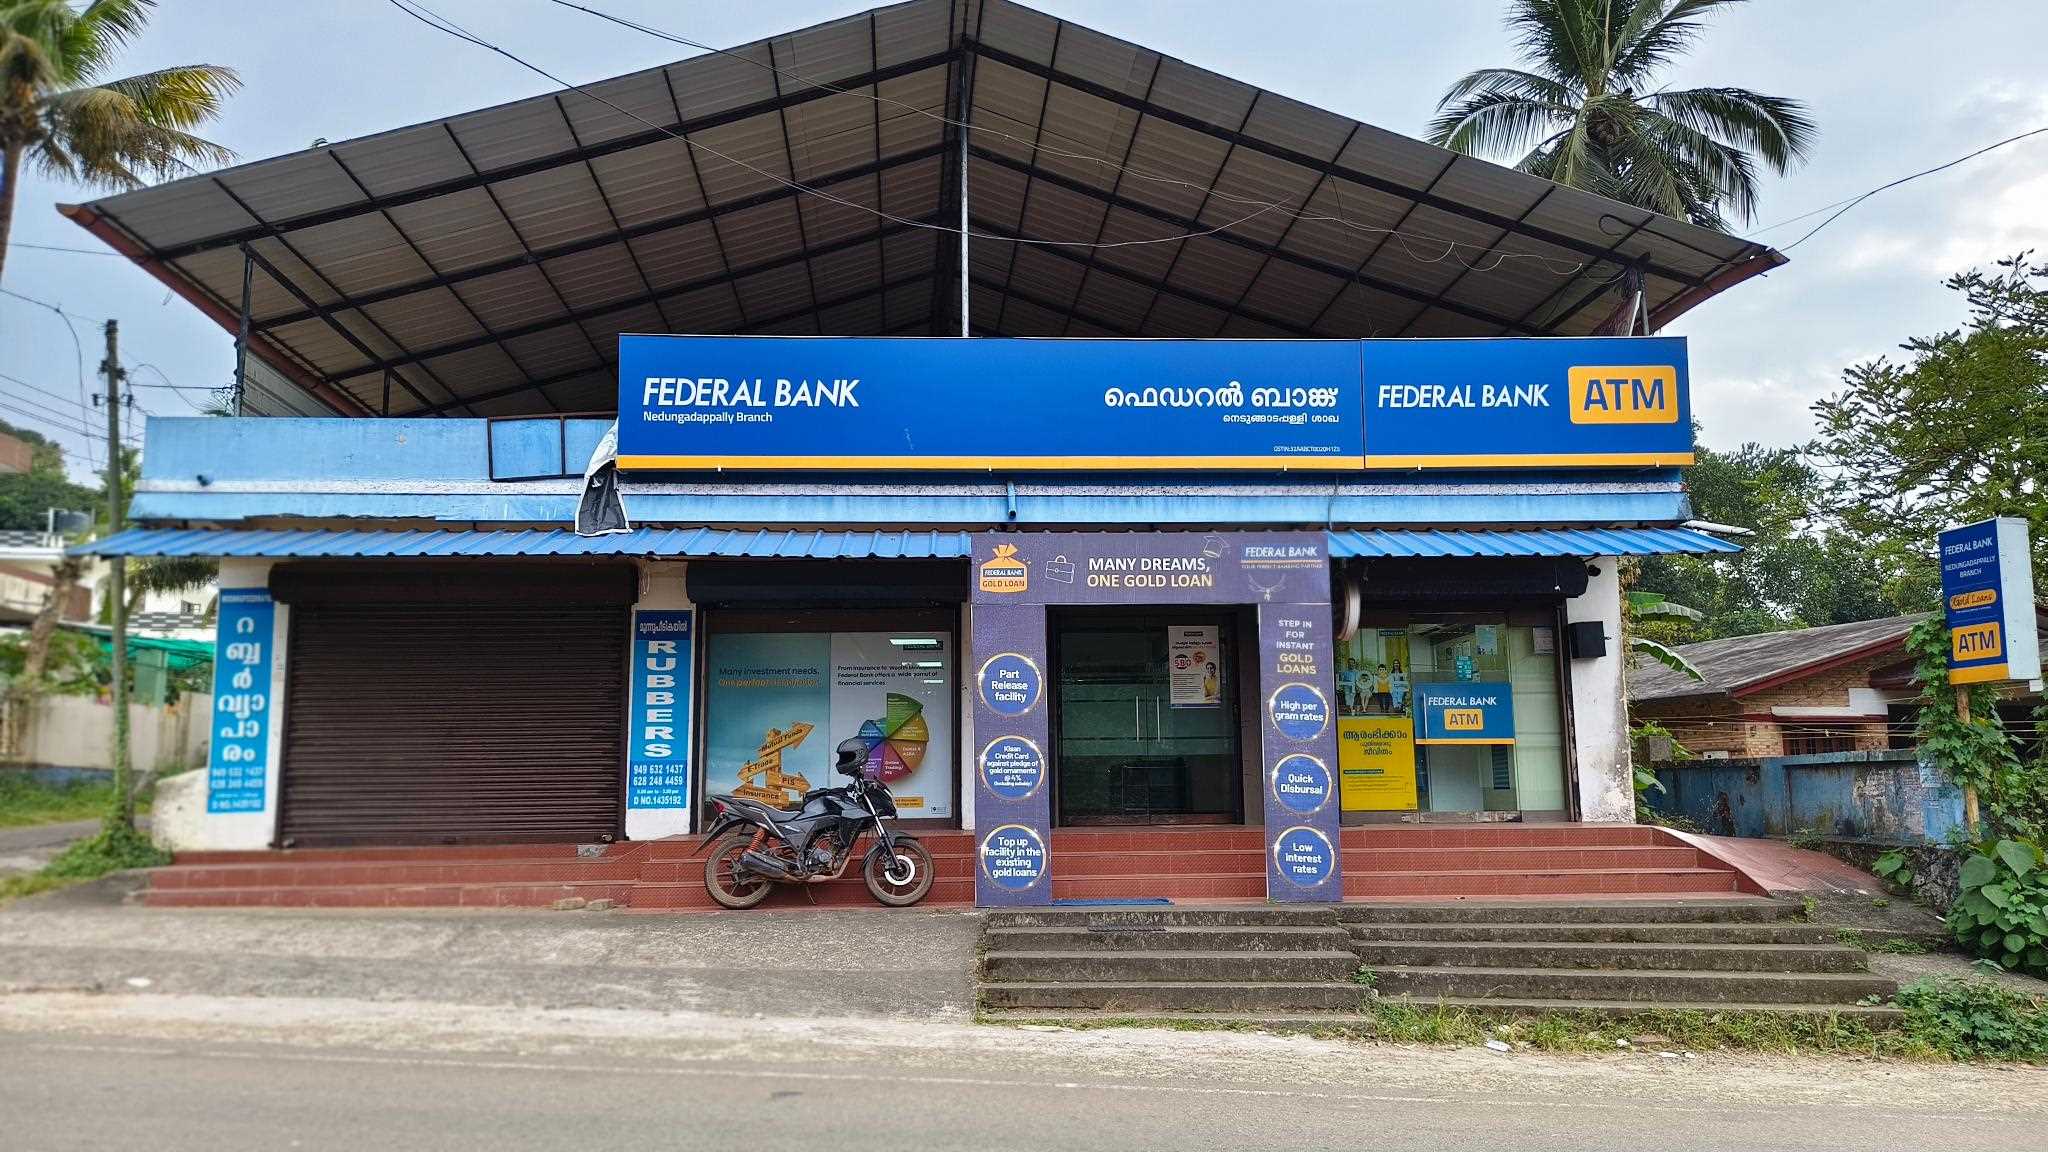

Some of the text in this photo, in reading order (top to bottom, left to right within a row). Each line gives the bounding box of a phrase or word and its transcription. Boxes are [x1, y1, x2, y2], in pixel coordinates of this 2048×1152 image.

[643, 377, 860, 408] FEDERAL BANK
[1104, 381, 1339, 407] ഫെഡറൽ ബാങ്ക്
[1378, 384, 1550, 408] FEDERAL BANK
[1584, 379, 1665, 411] ATM
[643, 411, 773, 424] Nedungadappally Branch
[1245, 546, 1318, 557] FEDERAL BANK
[1945, 537, 1993, 556] FEDERAL BANK
[1088, 557, 1210, 573] MANY DREAMS,
[1959, 569, 1982, 578] BRANCH
[1087, 574, 1213, 587] ONE GOLD LOAN
[1278, 619, 1312, 629] STEP IN
[1286, 630, 1305, 639] FOR
[1276, 640, 1314, 650] INSTANT
[1958, 630, 1995, 653] ATM
[1279, 652, 1313, 663] GOLD
[720, 667, 742, 676] Many
[743, 666, 791, 676] investment
[999, 669, 1019, 679] Part
[1276, 663, 1317, 675] LOANS
[991, 680, 1028, 690] Release
[644, 641, 677, 758] RUBBERS
[994, 691, 1027, 703] facility
[1428, 696, 1497, 706] FEDERAL BANK
[1280, 700, 1318, 712] High per
[1275, 712, 1324, 723] gram rates
[1449, 713, 1480, 726] ATM
[761, 735, 783, 752] Mutual
[994, 752, 1030, 760] Credit Card
[986, 760, 1009, 768] against
[1009, 760, 1031, 768] pledge
[989, 767, 1037, 776] gold ornaments
[781, 776, 795, 786] PIS
[1288, 773, 1313, 785] Quick
[743, 789, 780, 800] Insurance
[1280, 783, 1323, 795] Disbursal
[998, 836, 1028, 849] Top up
[1293, 842, 1313, 852] Low
[986, 847, 1041, 859] facility in the
[1285, 852, 1322, 864] interest
[995, 857, 1032, 869] existing
[1293, 863, 1317, 874] rates
[992, 866, 1038, 879] gold loans
